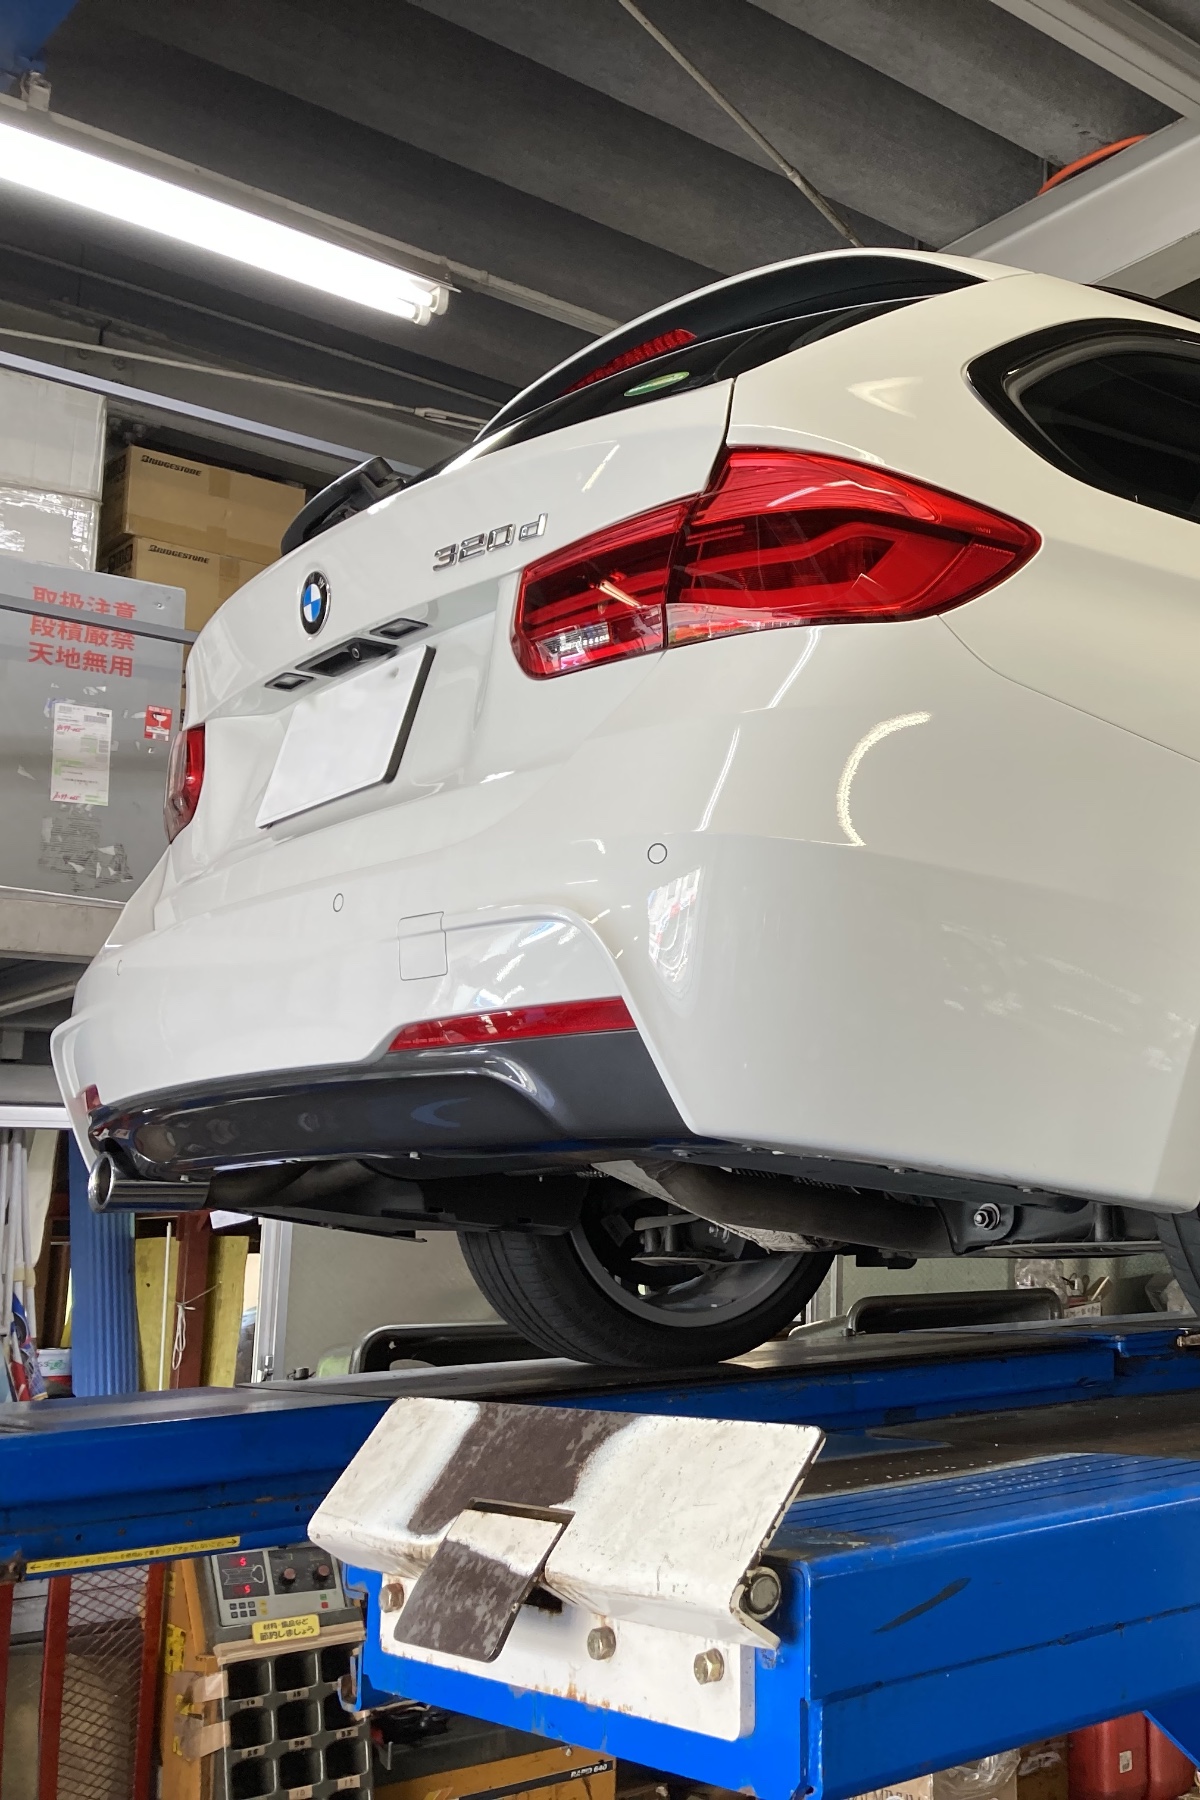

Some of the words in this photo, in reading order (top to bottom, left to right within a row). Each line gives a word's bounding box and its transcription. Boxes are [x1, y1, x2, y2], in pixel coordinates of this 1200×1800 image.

[141, 454, 202, 476] BRIDGESTONE
[148, 544, 210, 564] BRIDGESTONE
[432, 512, 549, 572] 320d
[28, 641, 133, 678] 天地無用
